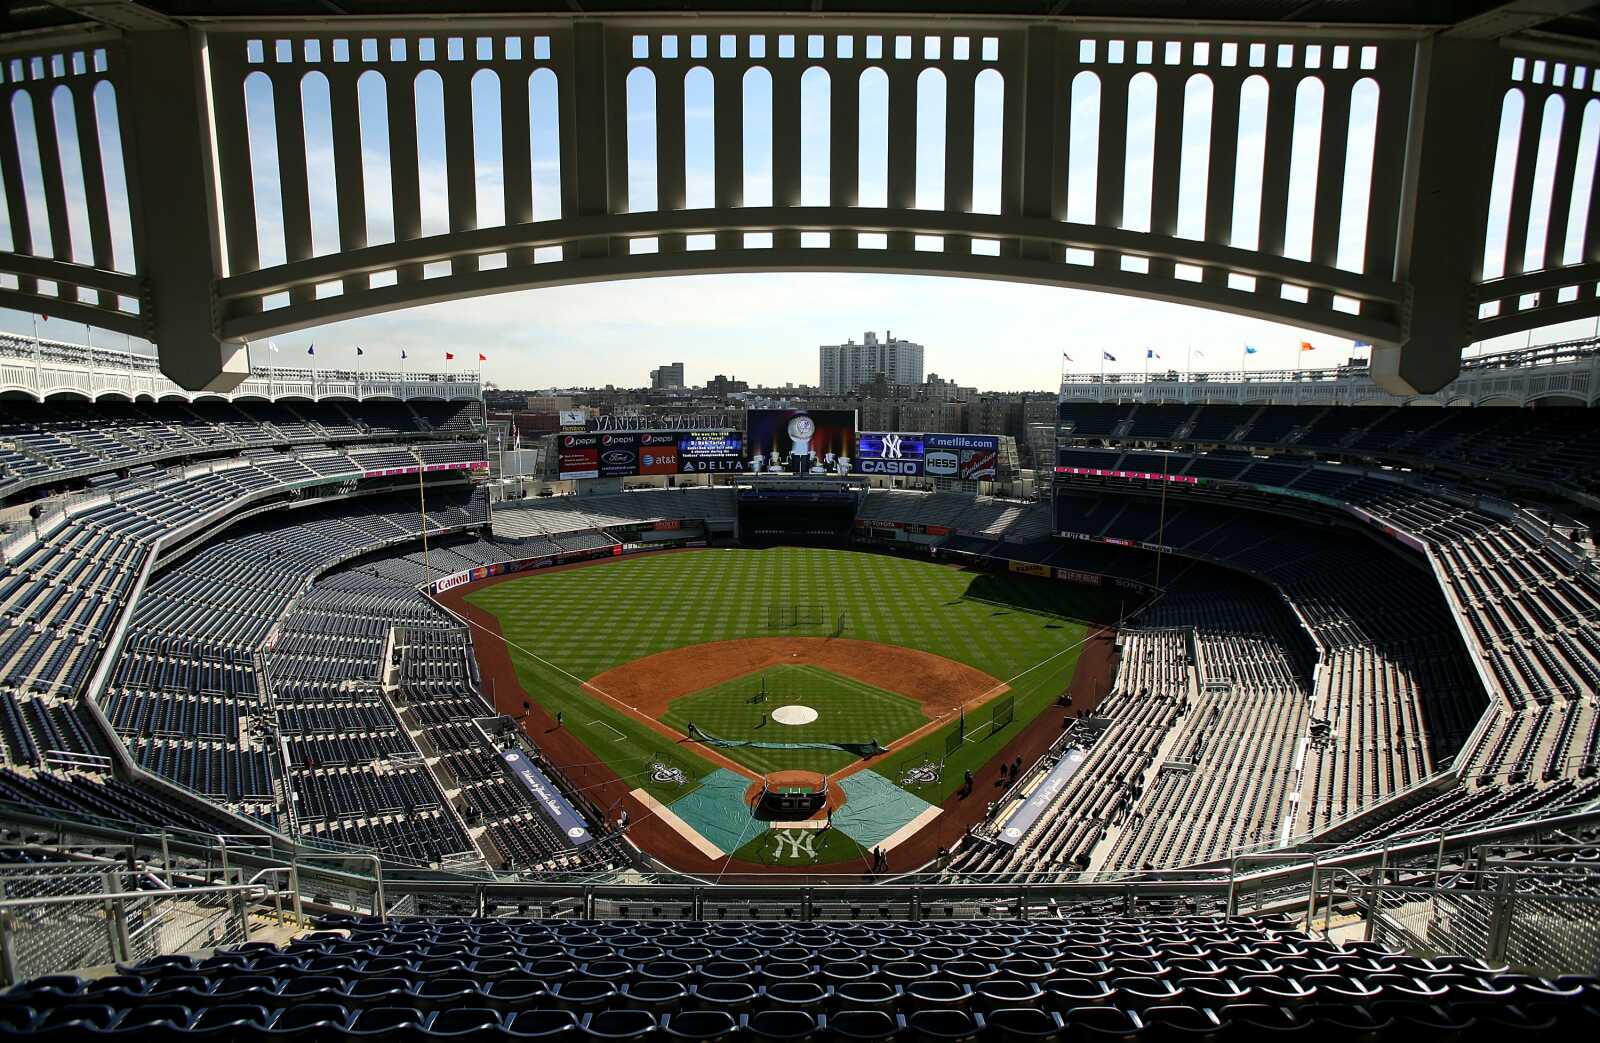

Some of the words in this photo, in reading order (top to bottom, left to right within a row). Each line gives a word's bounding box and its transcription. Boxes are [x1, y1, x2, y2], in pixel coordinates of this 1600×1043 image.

[593, 414, 656, 430] YANKEE
[661, 414, 728, 430] STADIUM
[613, 436, 634, 445] pepsi
[652, 435, 673, 443] pepsi
[938, 438, 993, 448] metlife.com
[881, 433, 902, 458] NY
[655, 455, 676, 464] at&t
[927, 458, 956, 469] HESS
[698, 461, 743, 470] DELTA
[861, 460, 917, 474] CASIO
[438, 573, 468, 591] Canon
[773, 829, 817, 859] NY
